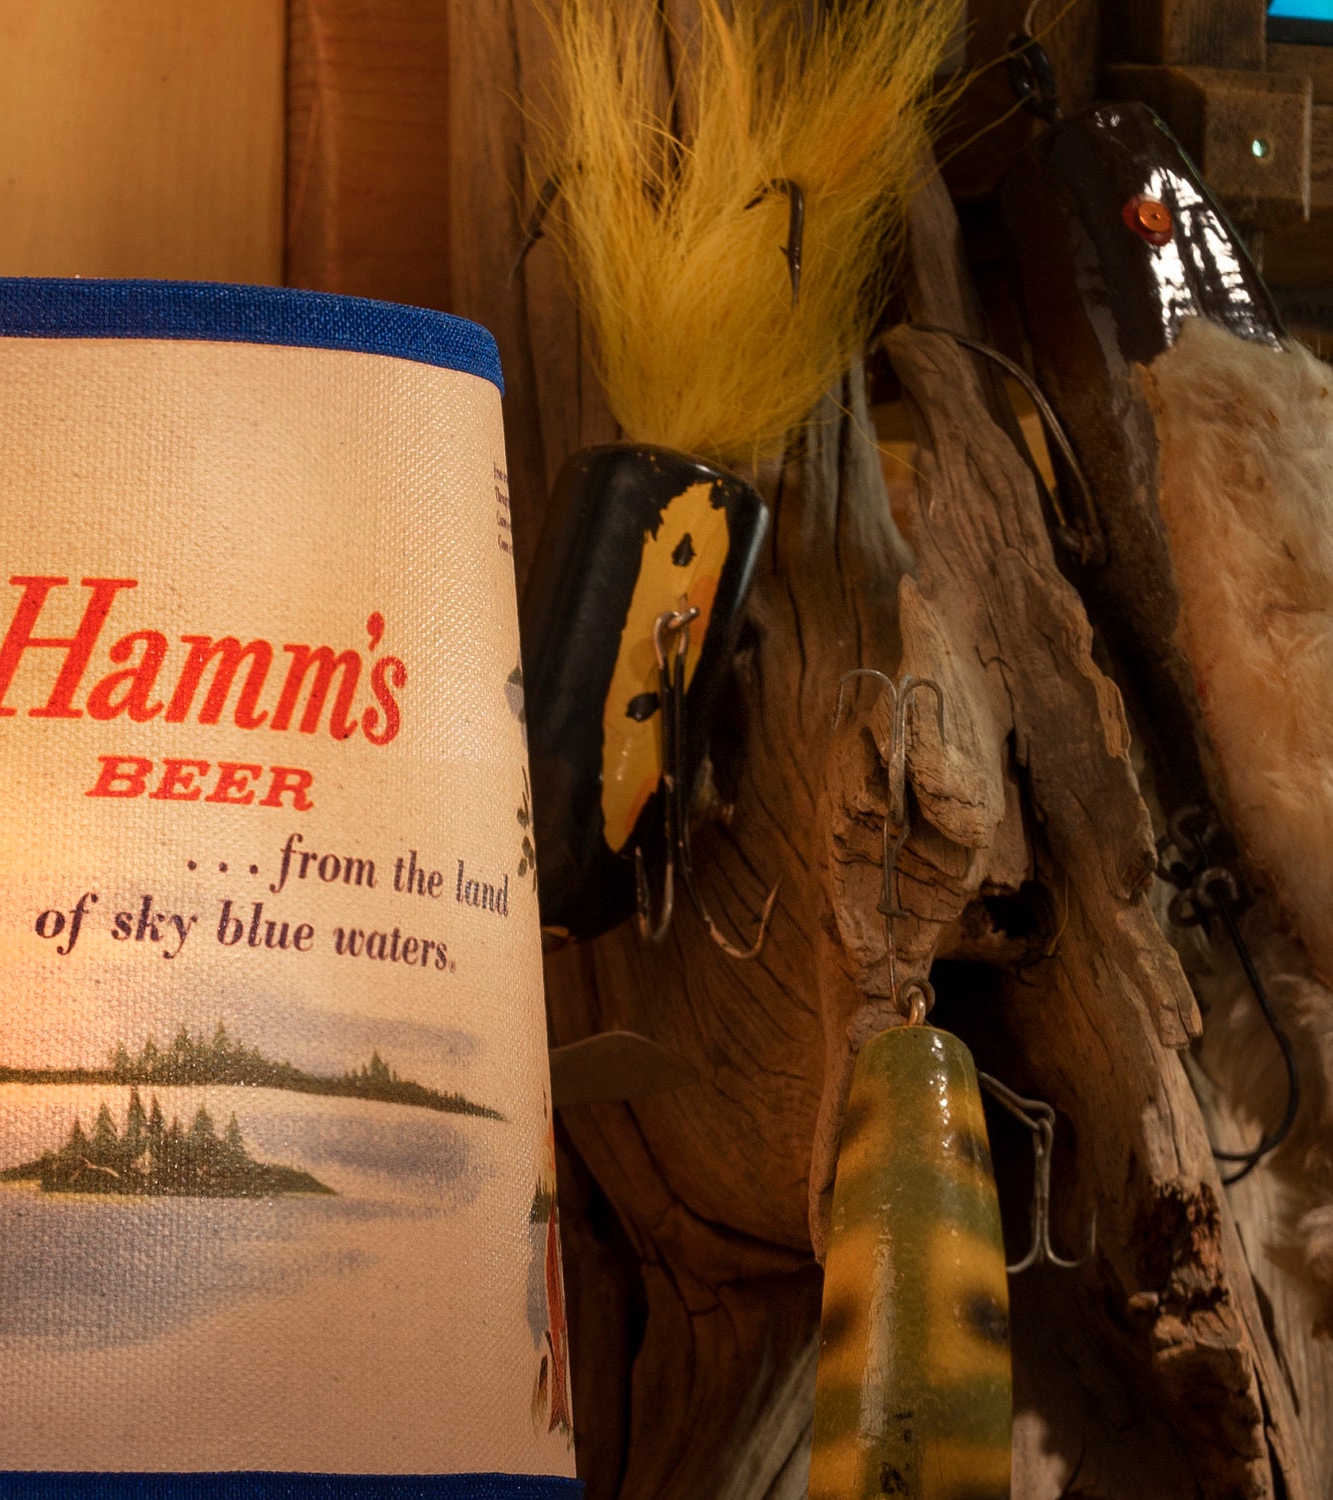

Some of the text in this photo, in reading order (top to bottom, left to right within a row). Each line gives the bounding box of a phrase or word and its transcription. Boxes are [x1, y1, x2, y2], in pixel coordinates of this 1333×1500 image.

[85, 755, 315, 812] BEER
[392, 849, 444, 899] the
[456, 860, 510, 917] land
[34, 892, 98, 955] of
[110, 895, 198, 959] sky
[217, 900, 315, 953] blue
